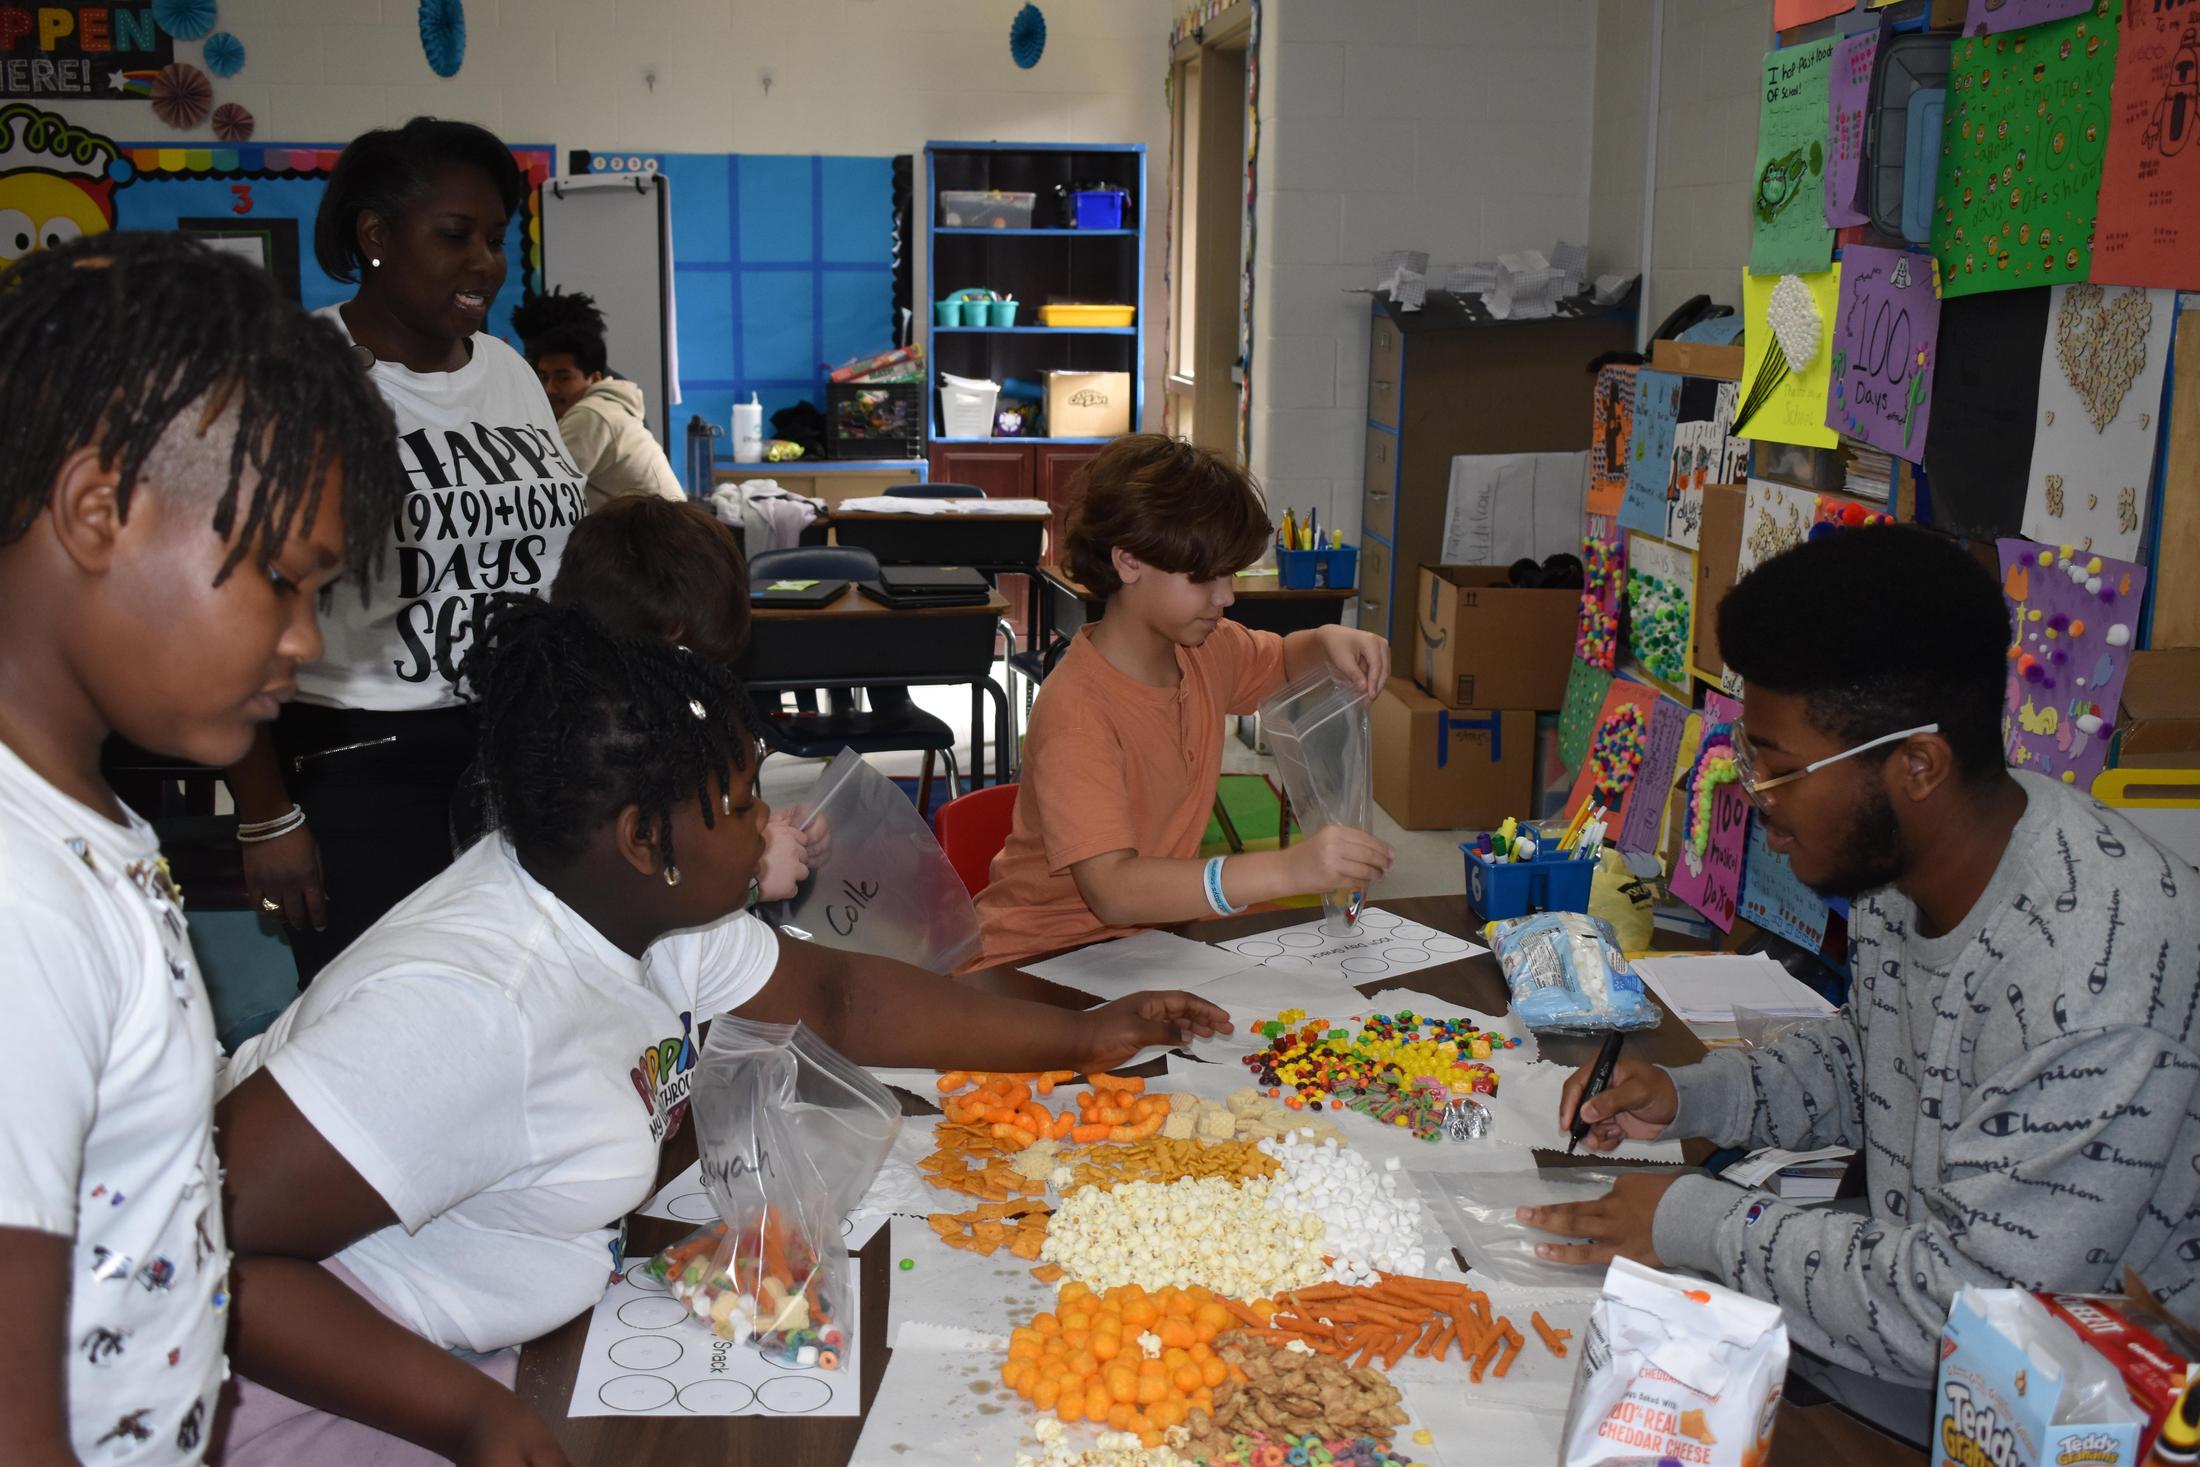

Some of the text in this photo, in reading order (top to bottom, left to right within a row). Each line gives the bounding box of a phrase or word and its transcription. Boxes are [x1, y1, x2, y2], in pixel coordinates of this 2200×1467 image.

[0, 8, 156, 51] PPEN
[0, 59, 92, 93] ERE!
[2033, 102, 2106, 171] 100
[232, 184, 254, 214] 3
[1852, 294, 1911, 385] 100
[1856, 380, 1888, 416] Days
[398, 421, 584, 494] HAPPY
[395, 534, 547, 600] DAYS
[1716, 790, 1744, 834] 100
[1471, 866, 1482, 902] 6
[2055, 827, 2081, 912] Champion
[2087, 888, 2125, 995] Champion
[709, 1341, 732, 1374] Snack
[1643, 1406, 1678, 1436] REAL
[1598, 1421, 1712, 1466] CHEDDAR CHEESE
[2059, 1433, 2118, 1453] Teddy
